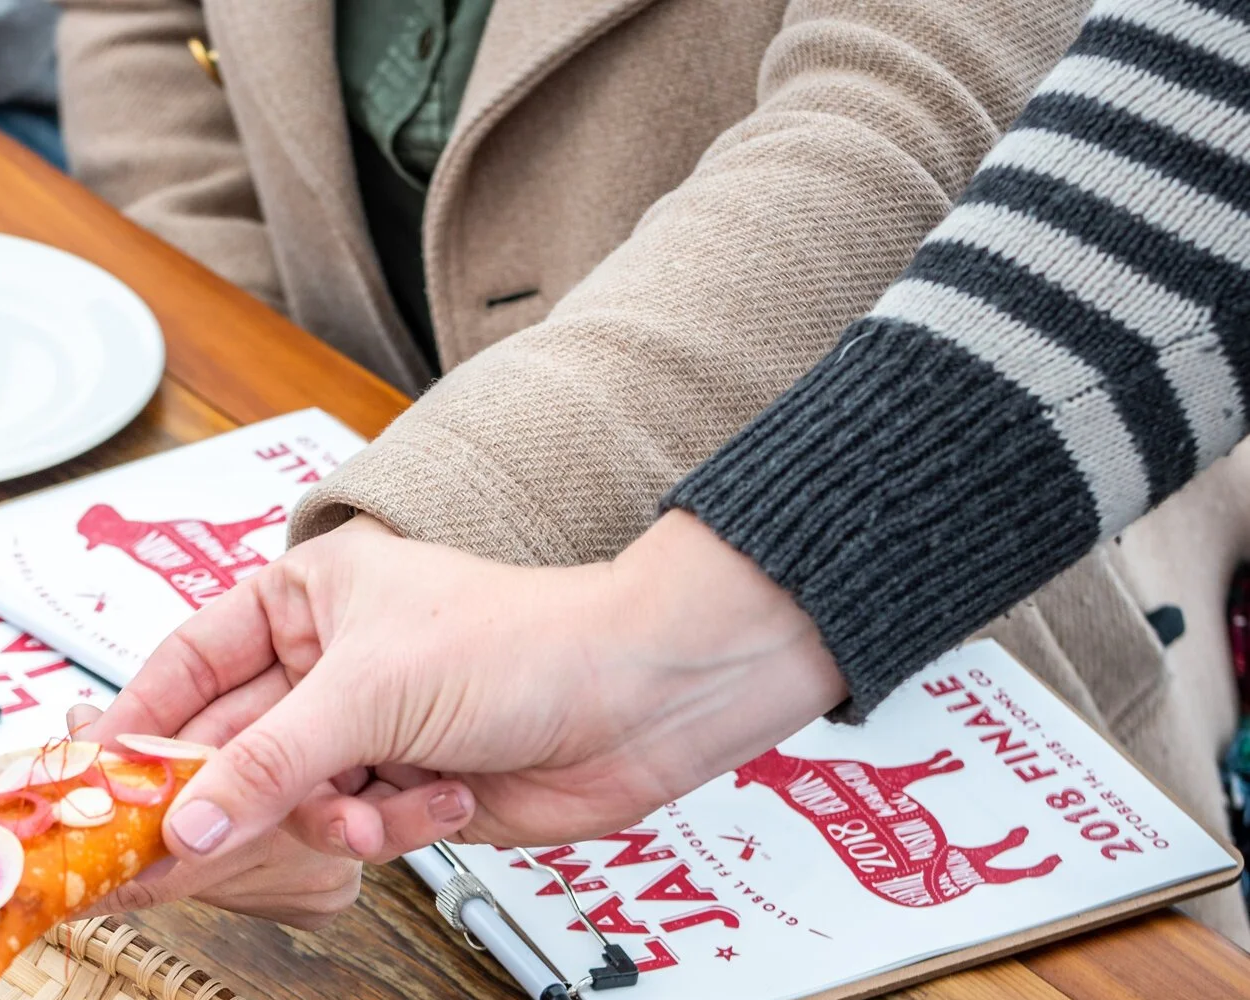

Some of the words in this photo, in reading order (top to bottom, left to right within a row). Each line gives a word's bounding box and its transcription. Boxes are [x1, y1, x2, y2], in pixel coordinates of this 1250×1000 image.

[170, 567, 223, 605] 018
[968, 668, 992, 687] CO
[921, 674, 1058, 783] FINALE
[992, 687, 1041, 732] LYONS,
[1046, 740, 1082, 769] 2018
[1082, 768, 1104, 789] 14,
[1045, 788, 1145, 861] 2018
[1099, 789, 1169, 849] OCTOBER
[675, 821, 733, 879] FLAVORS
[826, 818, 897, 873] 2018
[733, 879, 800, 927] GLOBAL
[938, 872, 960, 897] SAN
[497, 844, 680, 974] LAM
